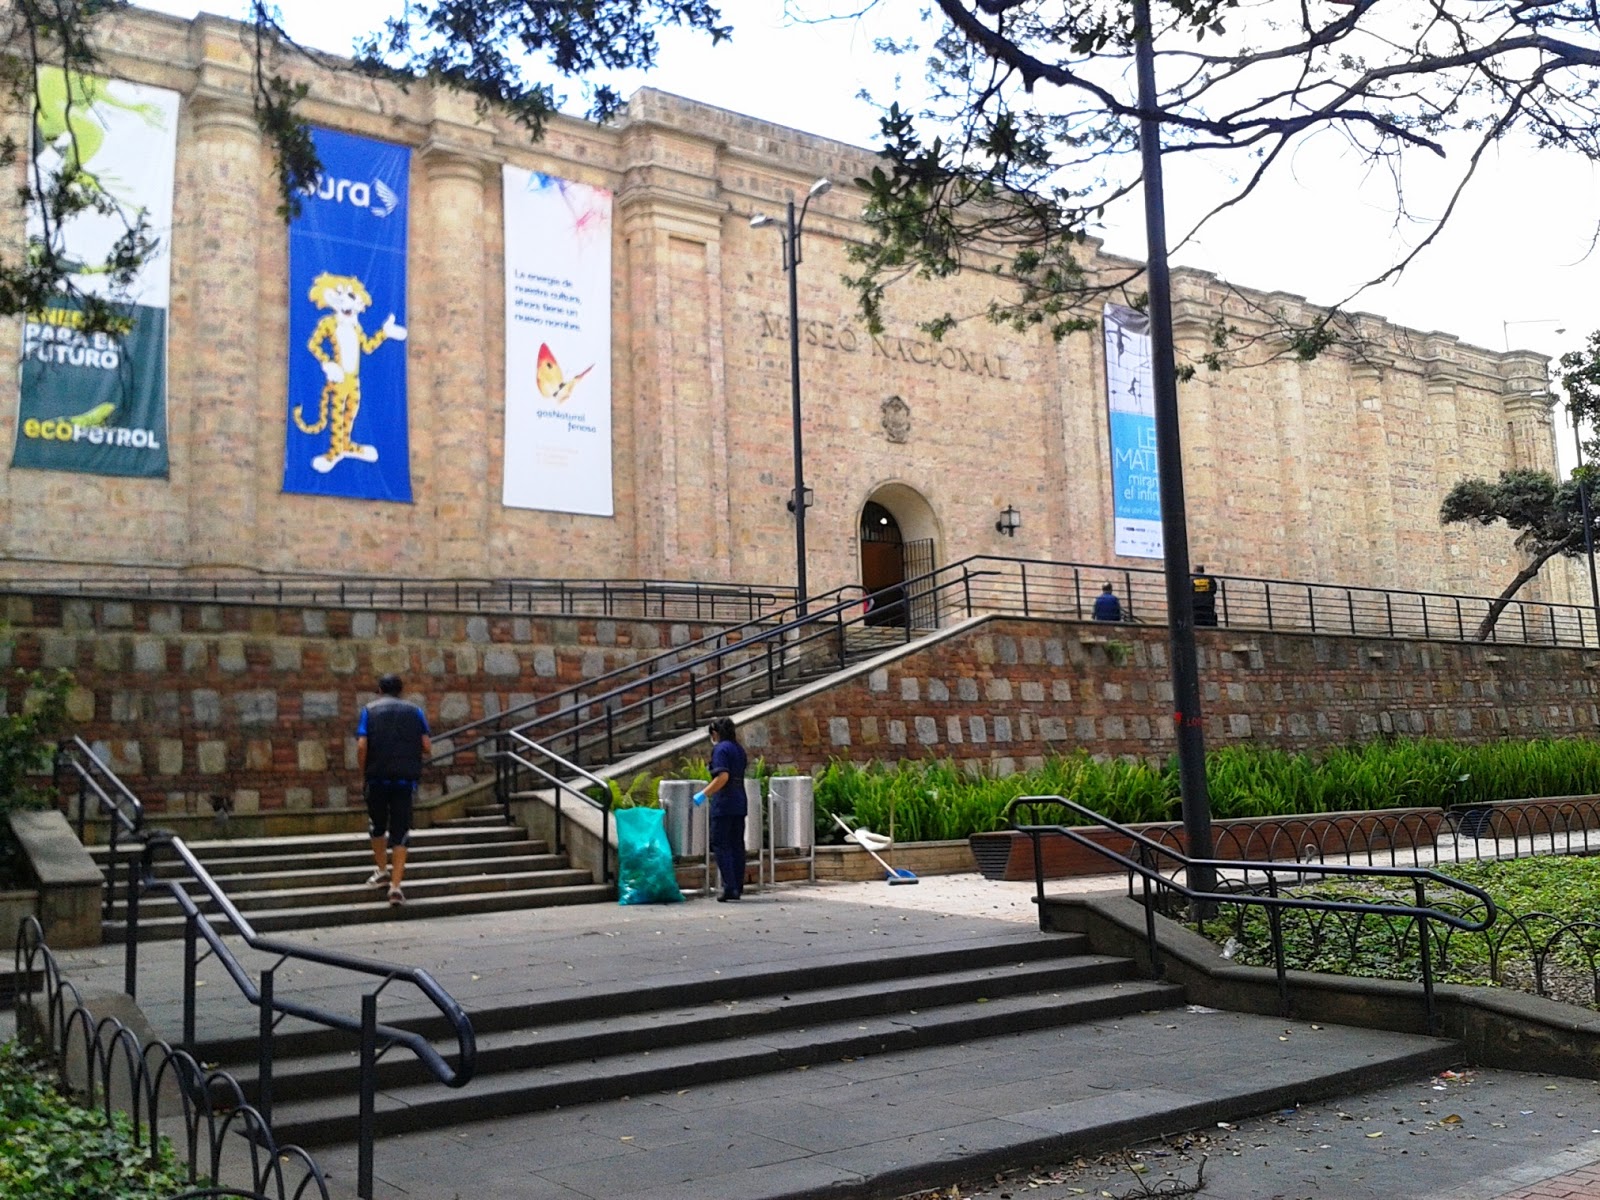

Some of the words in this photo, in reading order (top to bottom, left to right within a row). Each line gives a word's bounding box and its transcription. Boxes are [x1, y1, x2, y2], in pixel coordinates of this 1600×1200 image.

[26, 322, 90, 348] PARA
[759, 310, 858, 352] MSEO
[871, 334, 1012, 380] NACIONAL
[25, 341, 119, 370] FUTURO
[1115, 447, 1159, 473] MATI
[1128, 474, 1160, 488] miran
[1137, 487, 1160, 502] infin
